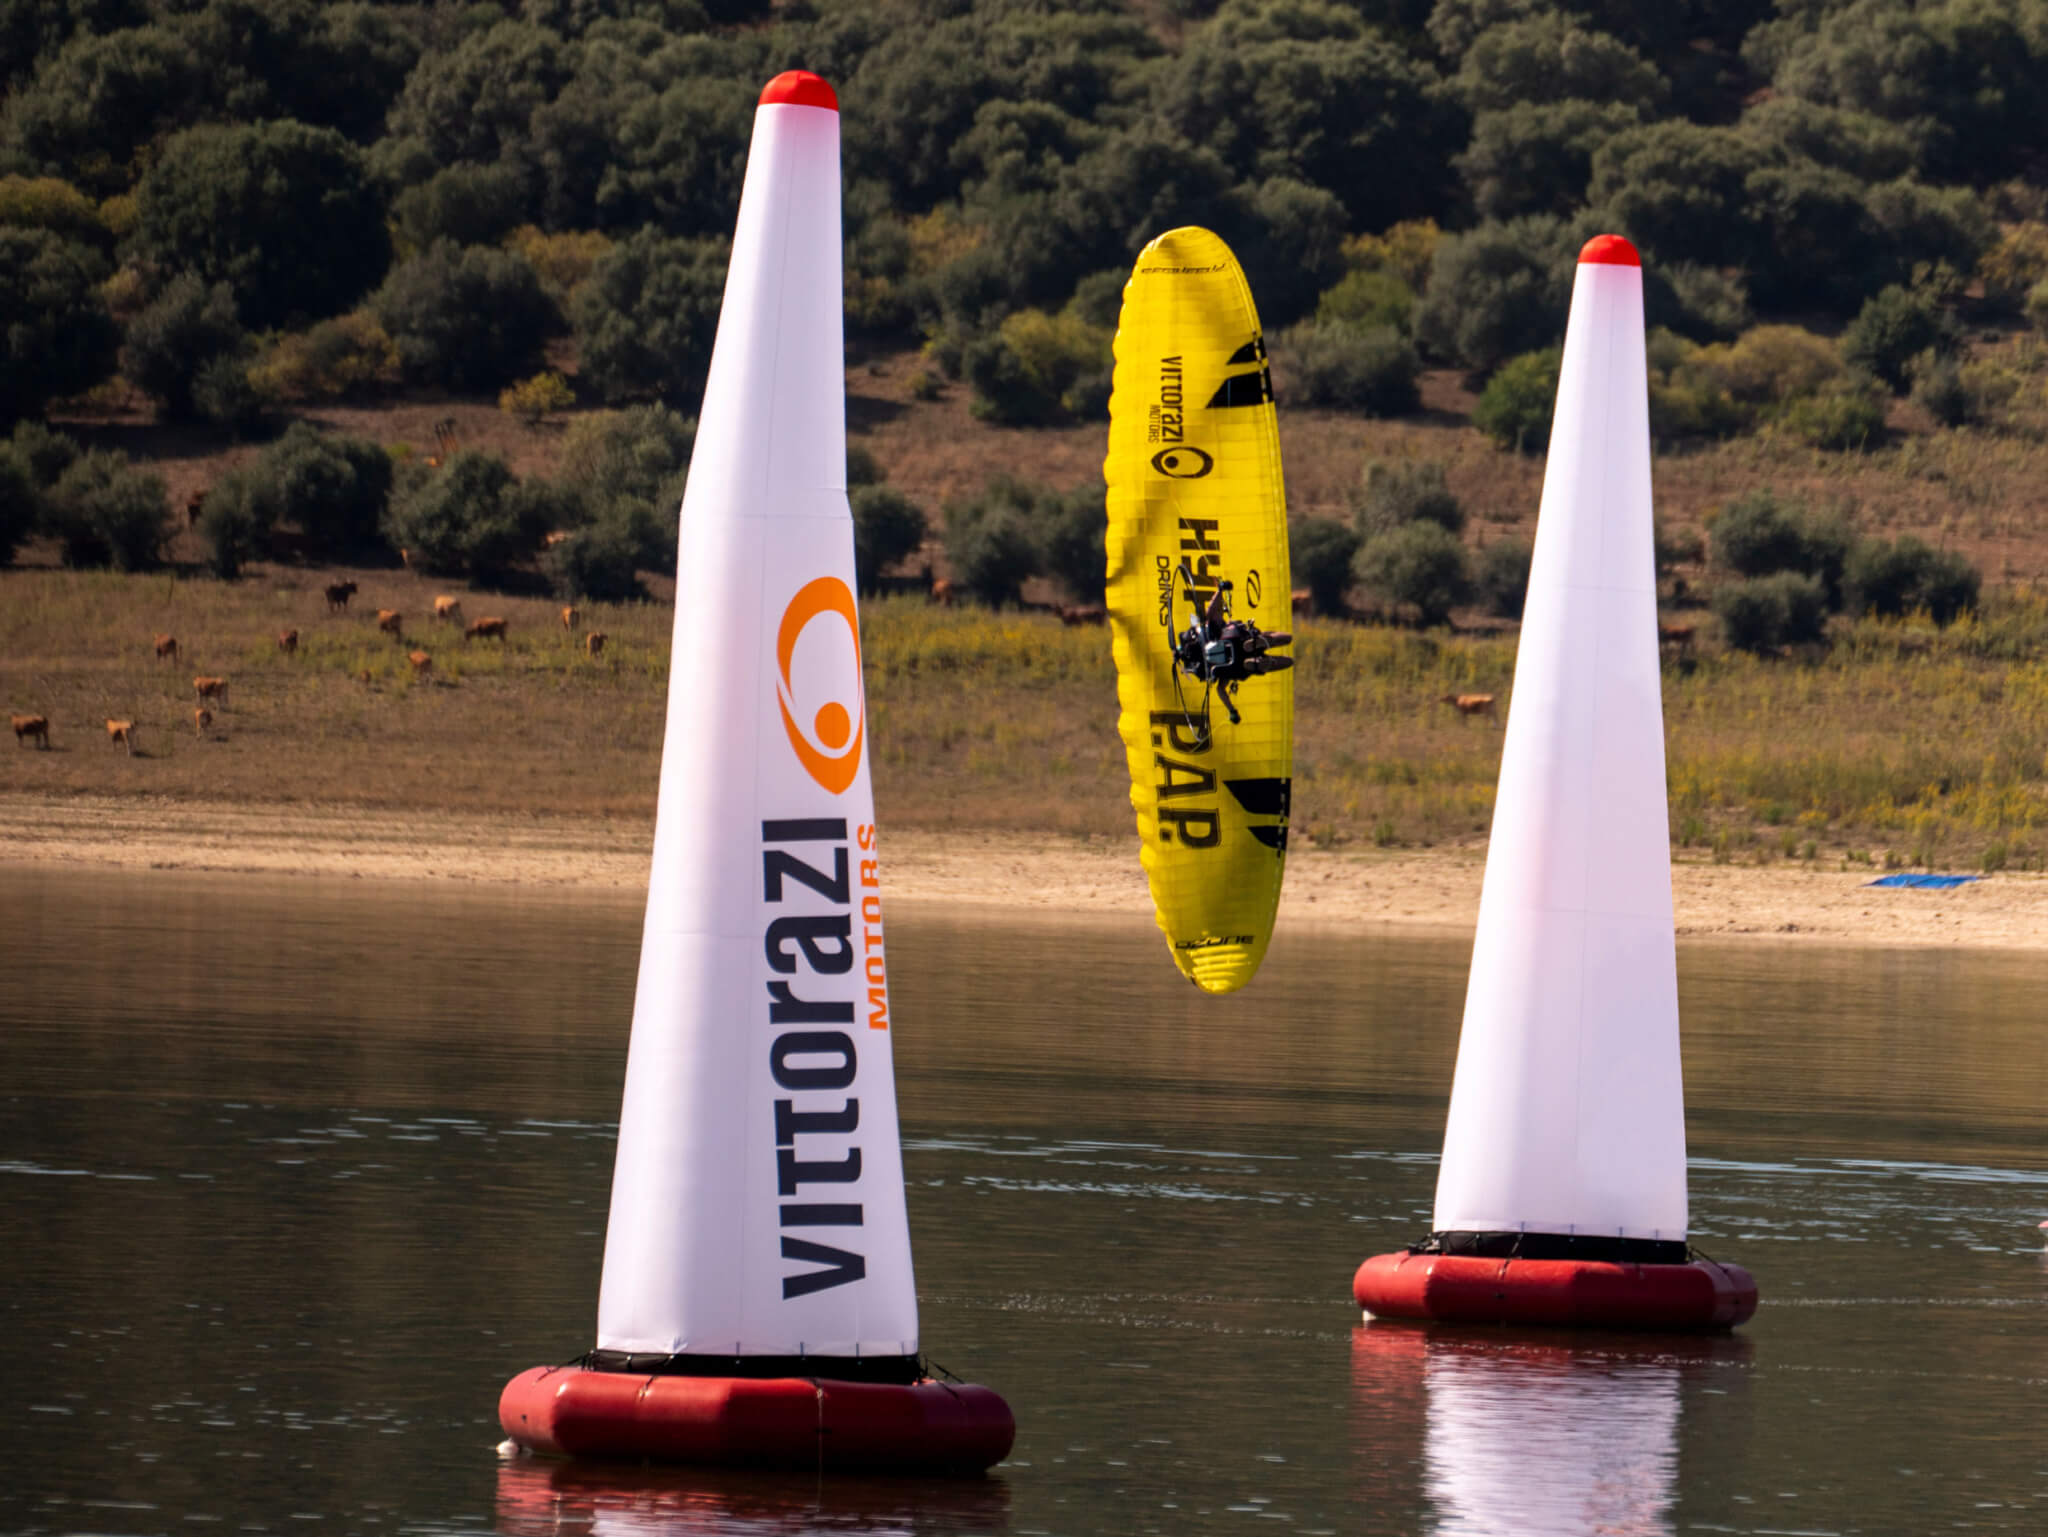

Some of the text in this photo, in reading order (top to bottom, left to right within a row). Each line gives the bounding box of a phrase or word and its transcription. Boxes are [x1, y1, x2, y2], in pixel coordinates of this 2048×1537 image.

[1148, 404, 1161, 443] MOTORS
[1156, 555, 1172, 626] DRINKS
[857, 823, 889, 1030] MOTORS
